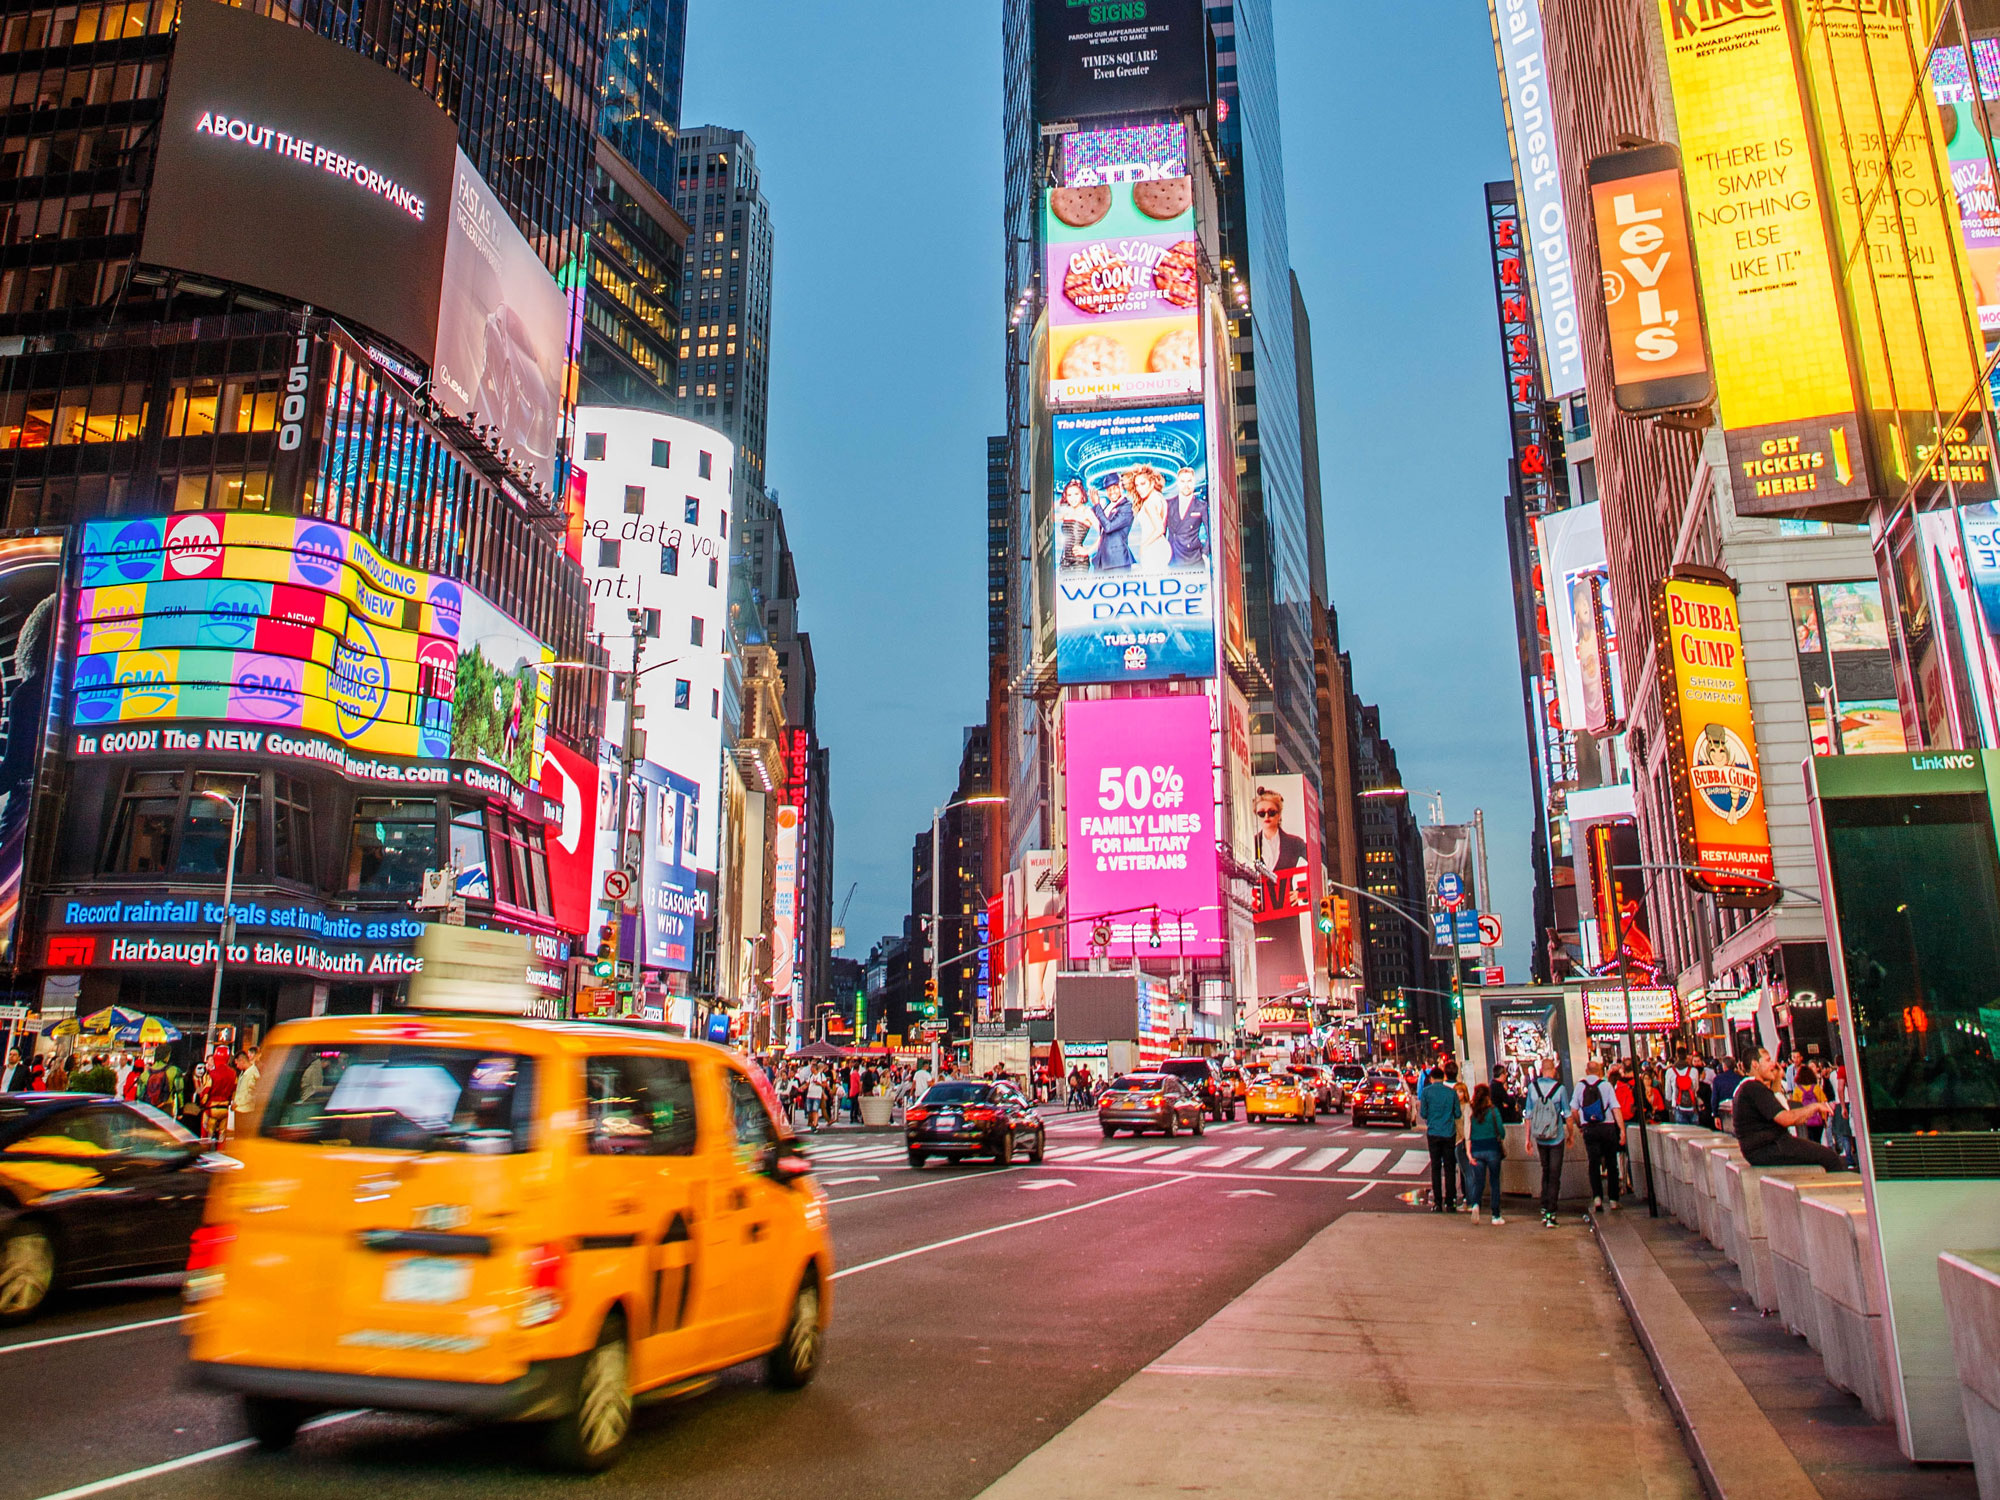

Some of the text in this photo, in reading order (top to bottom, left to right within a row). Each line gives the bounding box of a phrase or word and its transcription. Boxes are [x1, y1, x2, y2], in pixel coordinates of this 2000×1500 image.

[1089, 3, 1146, 24] SIGNS
[1668, 0, 1773, 40] KING
[1068, 25, 1169, 41] PARDON OUR APPEARANCE WHILE
[1089, 37, 1099, 45] WE
[1100, 36, 1119, 44] WORK
[1129, 33, 1147, 41] MAKE
[1675, 24, 1781, 54] THE AWARD-WINNING
[1082, 49, 1158, 68] TIMES SQUARE
[1696, 39, 1760, 58] BEST MUSICAL
[1094, 65, 1149, 80] Even Greater
[1775, 137, 1793, 158] IS
[197, 111, 426, 222] ABOUT THE PERFORMANCE
[1096, 160, 1177, 184] TDK
[1718, 165, 1787, 196] SIMPLY
[458, 172, 491, 235] FAST AS
[1515, 51, 1556, 191] Honest
[1538, 201, 1580, 376] Opinion.
[1697, 190, 1811, 229] NOTHING
[457, 207, 483, 252] THE LEXUS
[1735, 225, 1781, 250] ELSE
[1069, 240, 1172, 275] GIRL SCOUT
[1730, 257, 1768, 281] LIKE
[1075, 288, 1170, 306] INSPIRED COFFEE
[1098, 301, 1147, 313] FLAVORS
[1498, 219, 1545, 475] ERNST &
[278, 338, 309, 450] 1500
[447, 375, 469, 404] LEXUS
[1126, 379, 1181, 391] DONUTS
[1057, 411, 1200, 430] The biggest dance competition
[1107, 423, 1156, 435] the world.
[1761, 436, 1800, 455] GET
[1742, 451, 1824, 478] TICKETS
[1756, 474, 1817, 497] HERE!
[621, 514, 682, 549] data
[111, 539, 162, 561] GMA
[167, 535, 218, 555] GMA
[295, 541, 341, 568] GMA
[353, 542, 417, 595] INTRODUCING
[1060, 579, 1208, 601] WORLD OF
[211, 601, 260, 622] GMA
[365, 591, 395, 617] NEW
[1093, 597, 1203, 620] DANCE
[1669, 594, 1736, 633] BUBBA
[96, 605, 140, 628] GMA
[1104, 632, 1166, 646] TUES 5/29
[1680, 634, 1735, 669] GUMP
[1125, 659, 1147, 669] NBC
[119, 671, 172, 691] GMA
[239, 674, 296, 698] GMA
[1689, 676, 1736, 690] SHRIMP
[1685, 689, 1743, 705] COMPANY
[790, 729, 806, 784] Locker
[1912, 754, 1975, 771] LinkNYC
[78, 729, 555, 821] in GOOD! The NEW Check The
[1693, 767, 1757, 790] BUBBA GUMP
[1152, 791, 1184, 809] OFF
[1706, 787, 1749, 798] SHRIMP CO
[1080, 813, 1202, 836] FAMILY LINES
[1092, 835, 1191, 854] FOR MILITARY
[777, 864, 794, 872] NYC
[1096, 853, 1188, 871] & VETERANS
[1700, 850, 1769, 864] RESTAURANT
[657, 889, 695, 917] REASONS
[66, 901, 122, 924] Record
[123, 900, 199, 923] rainfall
[204, 902, 267, 925] totals
[270, 906, 297, 928] set
[298, 908, 311, 927] in
[366, 922, 388, 939] as
[657, 913, 678, 936] WHY
[1435, 914, 1445, 923] M7
[1436, 924, 1450, 934] M20
[1437, 934, 1453, 945] M104
[110, 938, 220, 967] Harbaugh
[225, 942, 249, 963] to
[254, 943, 294, 966] take
[318, 945, 364, 974] South
[368, 952, 424, 974] Africa
